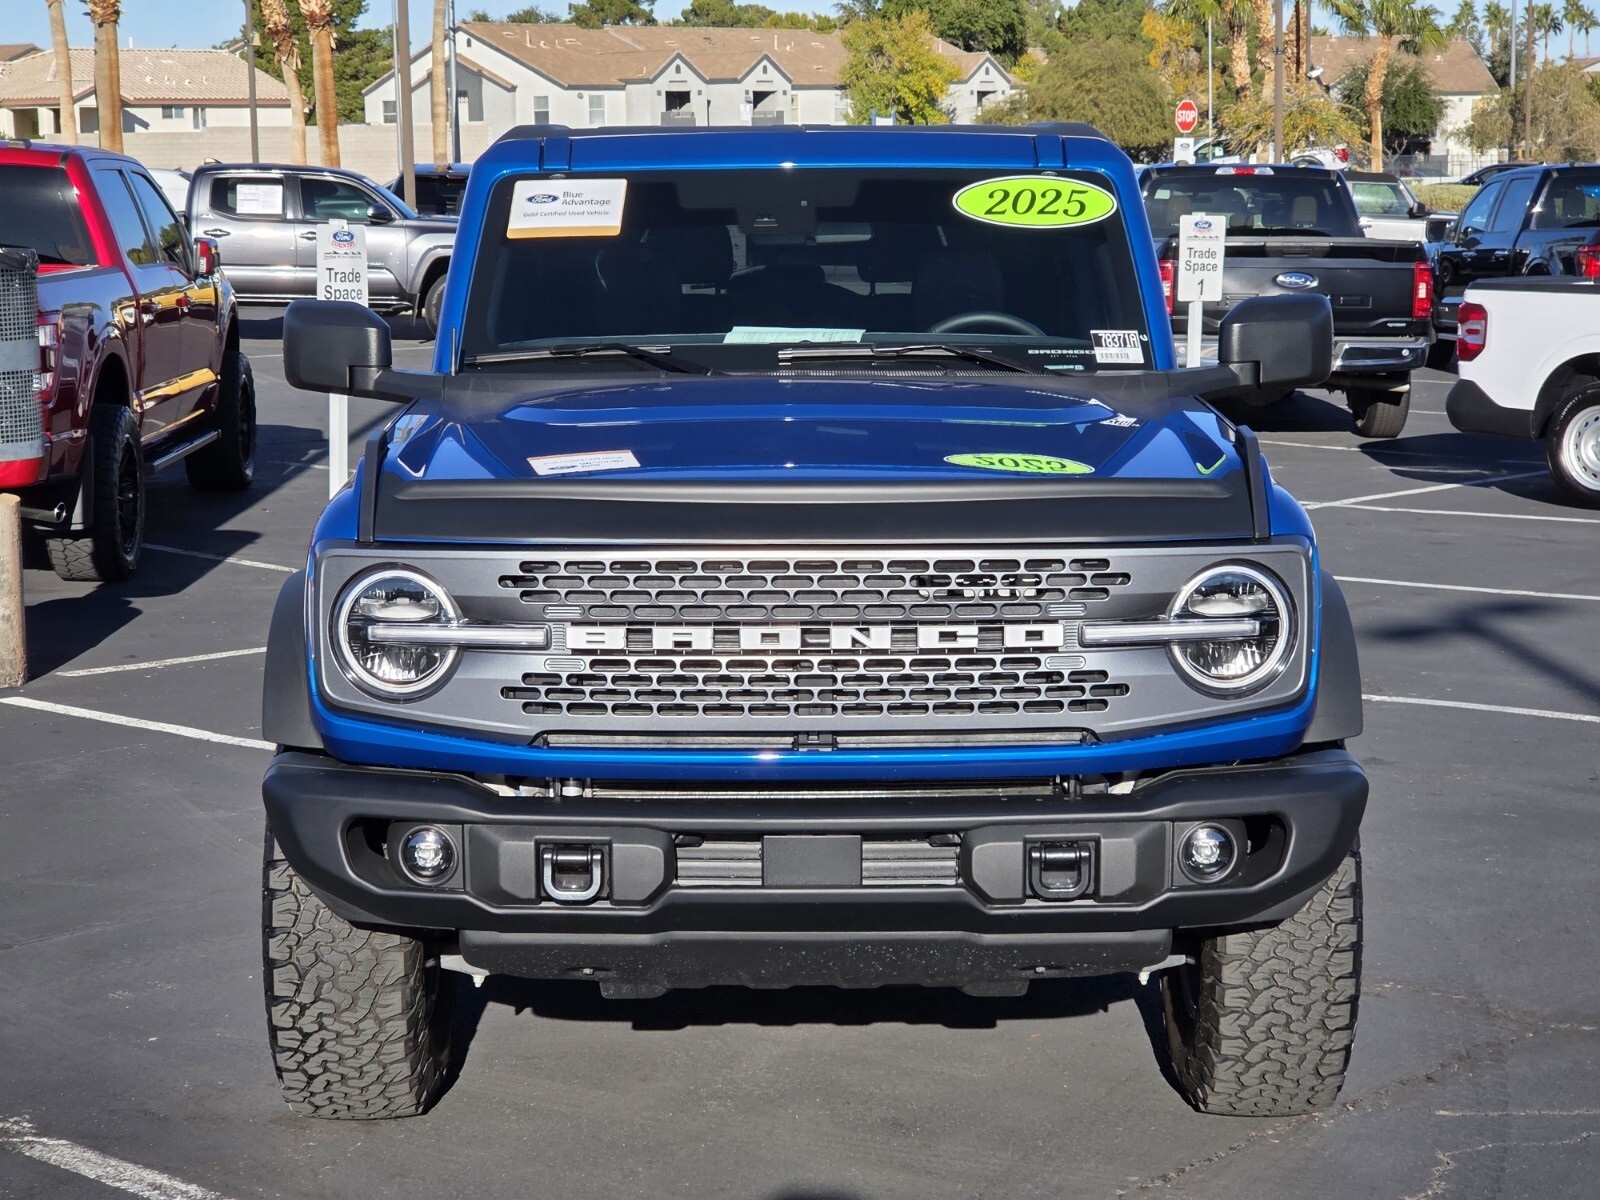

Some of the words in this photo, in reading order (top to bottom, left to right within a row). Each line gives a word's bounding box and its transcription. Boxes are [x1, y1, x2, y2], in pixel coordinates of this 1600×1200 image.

[1177, 110, 1196, 122] STOP
[530, 193, 556, 204] Ford
[561, 199, 612, 207] Advantage
[984, 188, 1089, 217] 2025
[335, 231, 353, 242] Ford
[1187, 247, 1217, 259] Trade
[1185, 260, 1218, 274] Space
[326, 267, 361, 283] Trade
[324, 285, 363, 301] Space
[1197, 278, 1204, 296] 1
[1098, 333, 1139, 348] 78371A
[566, 625, 1064, 650] BRONCO
